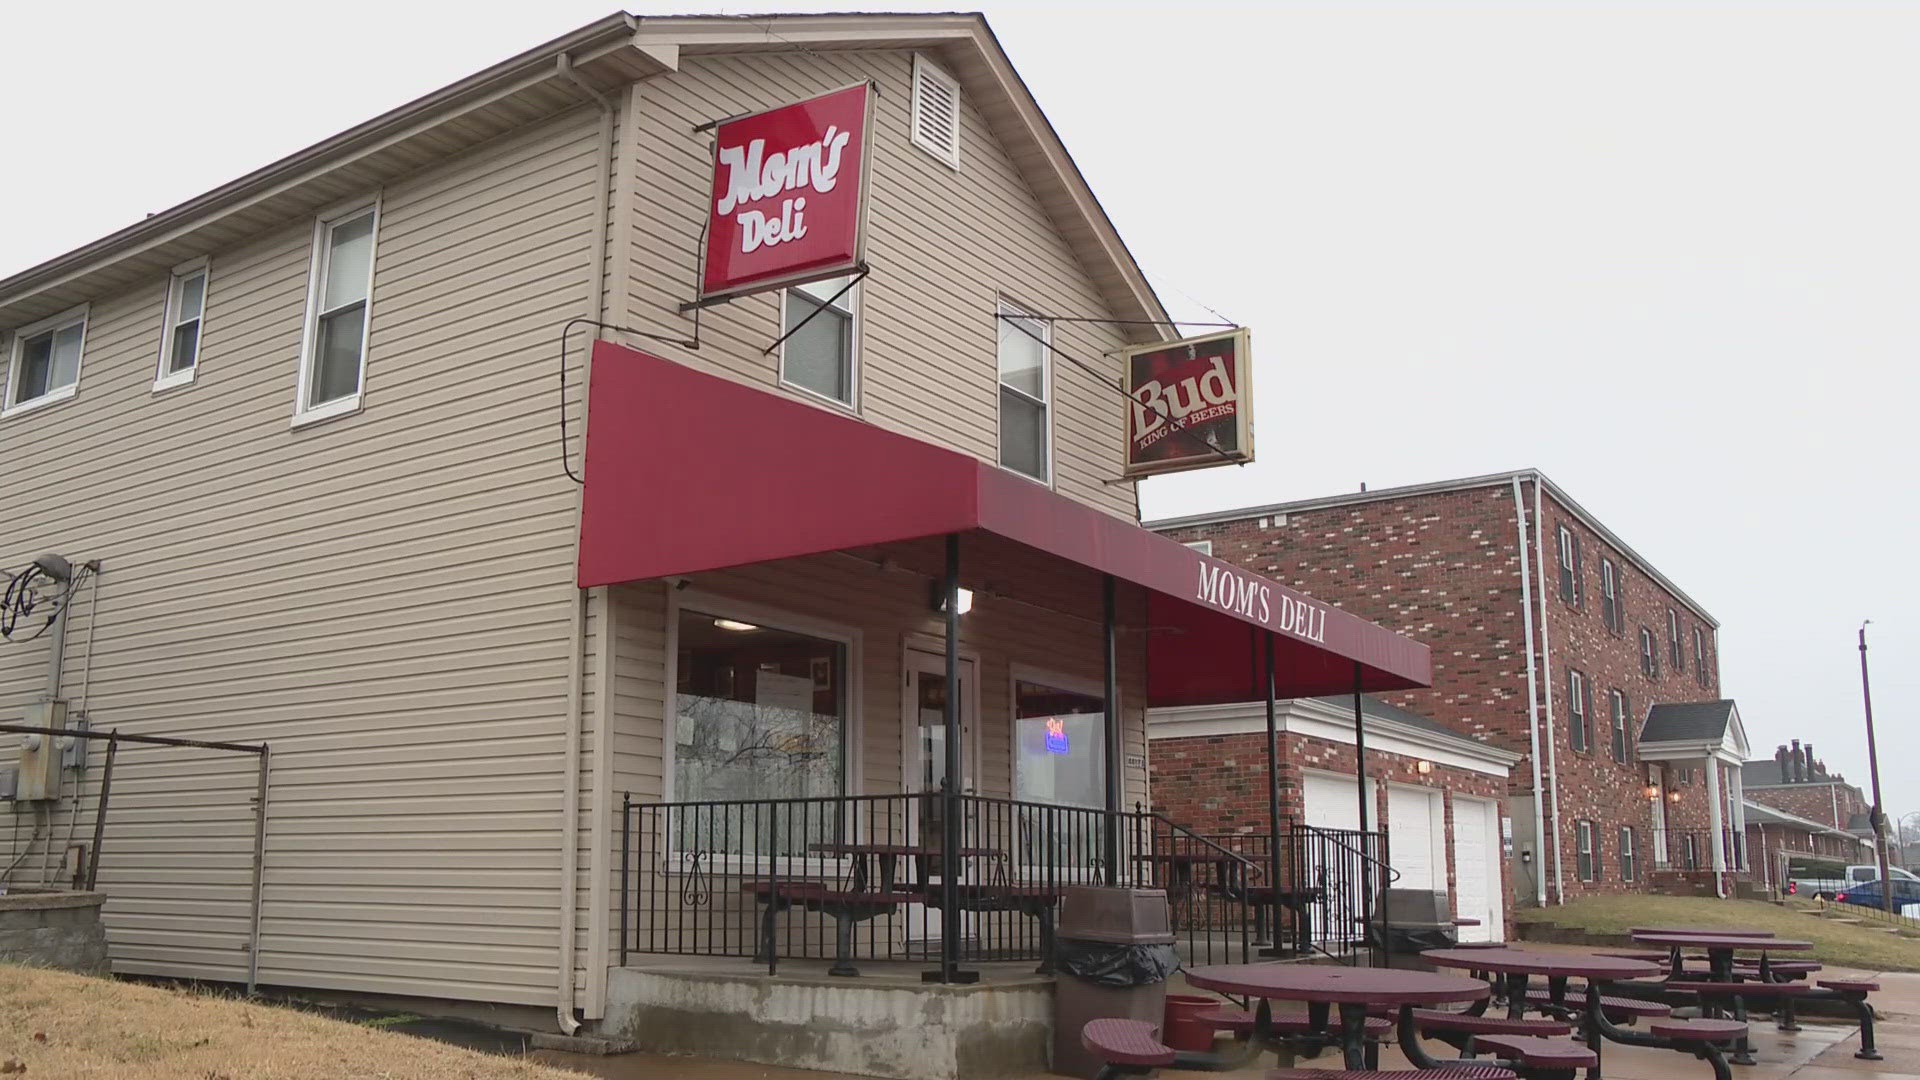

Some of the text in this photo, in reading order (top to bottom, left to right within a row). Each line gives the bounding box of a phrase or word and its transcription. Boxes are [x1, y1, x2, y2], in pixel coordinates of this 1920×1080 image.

[717, 125, 850, 216] Mom's
[737, 197, 807, 253] Deli
[1130, 356, 1237, 442] Bud
[1139, 427, 1168, 450] KING
[1190, 404, 1234, 425] BEERS
[1197, 561, 1326, 644] MOM'S DELI
